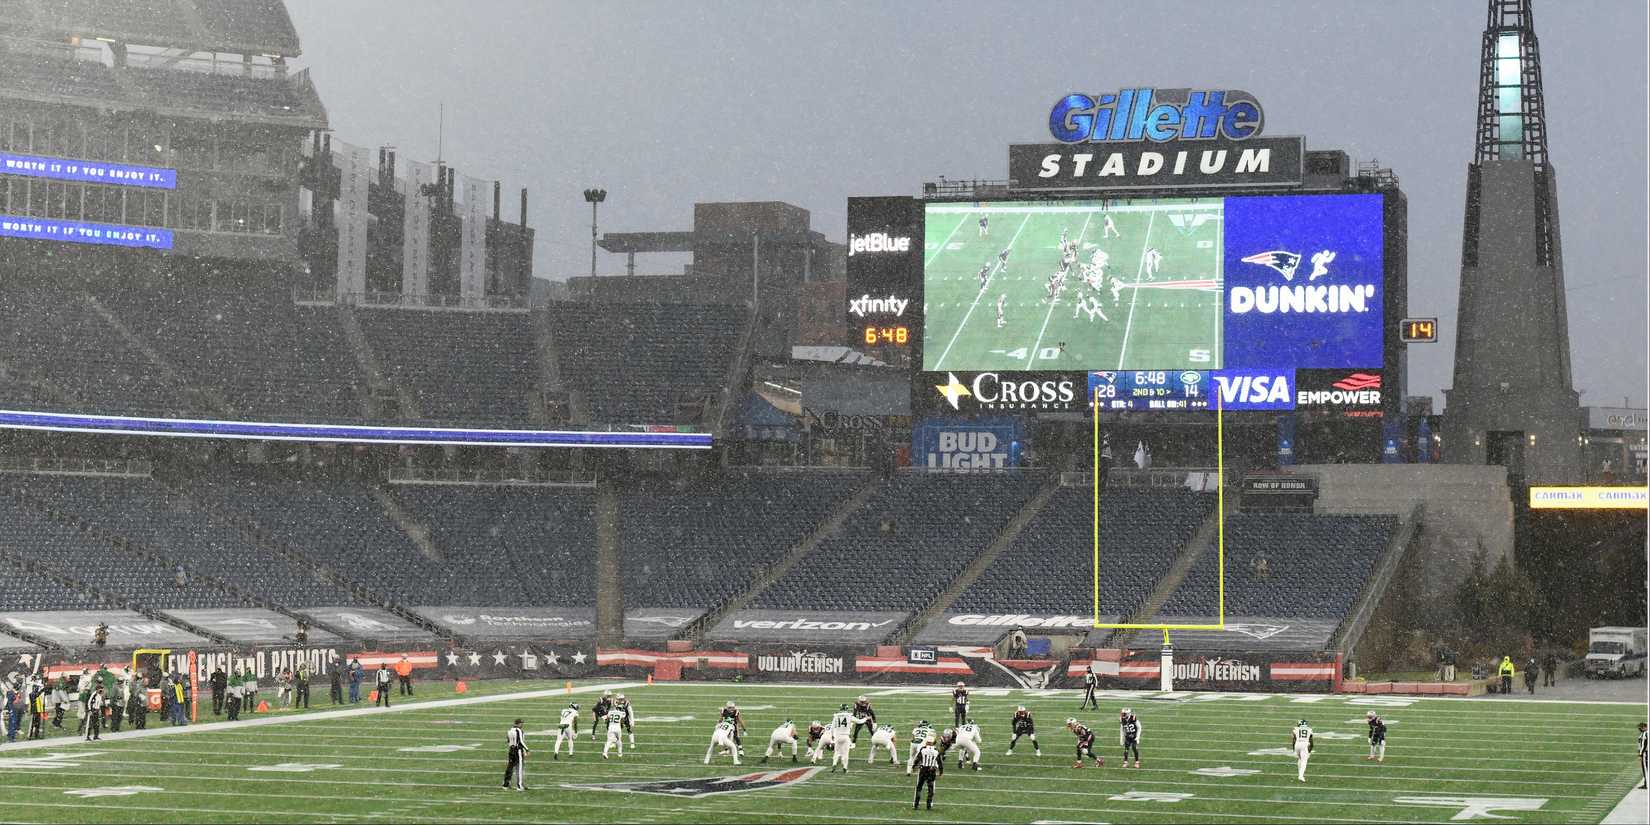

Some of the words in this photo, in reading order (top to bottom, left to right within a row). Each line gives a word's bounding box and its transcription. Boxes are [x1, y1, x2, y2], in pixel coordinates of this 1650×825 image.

[1050, 87, 1263, 143] Gillette
[6, 160, 45, 171] WORTH
[51, 164, 61, 172] IT
[82, 167, 104, 176] YOU
[109, 169, 144, 180] ENJOY
[1038, 149, 1270, 178] STADIUM
[2, 222, 41, 232] WORTH
[80, 228, 100, 237] YOU
[106, 231, 141, 240] ENJOY
[146, 234, 160, 242] IT.
[849, 233, 911, 256] jetBlue
[849, 295, 908, 316] xfinity
[1230, 284, 1375, 313] DUNKIN'
[865, 327, 908, 344] 6:48
[1411, 323, 1432, 337] 14
[1135, 371, 1166, 385] 6:48
[972, 373, 1074, 402] CROSS
[1098, 384, 1116, 398] 28
[1156, 388, 1166, 396] 10
[1184, 384, 1199, 397] 14
[1213, 376, 1290, 403] VISA
[1298, 391, 1381, 404] EMPOWER
[939, 432, 998, 452] BUD
[928, 453, 1008, 473] LIGHT
[734, 618, 873, 631] verizon
[948, 614, 1097, 627] Gillette
[838, 717, 848, 728] 14
[915, 729, 928, 738] 25
[1298, 729, 1308, 738] 19
